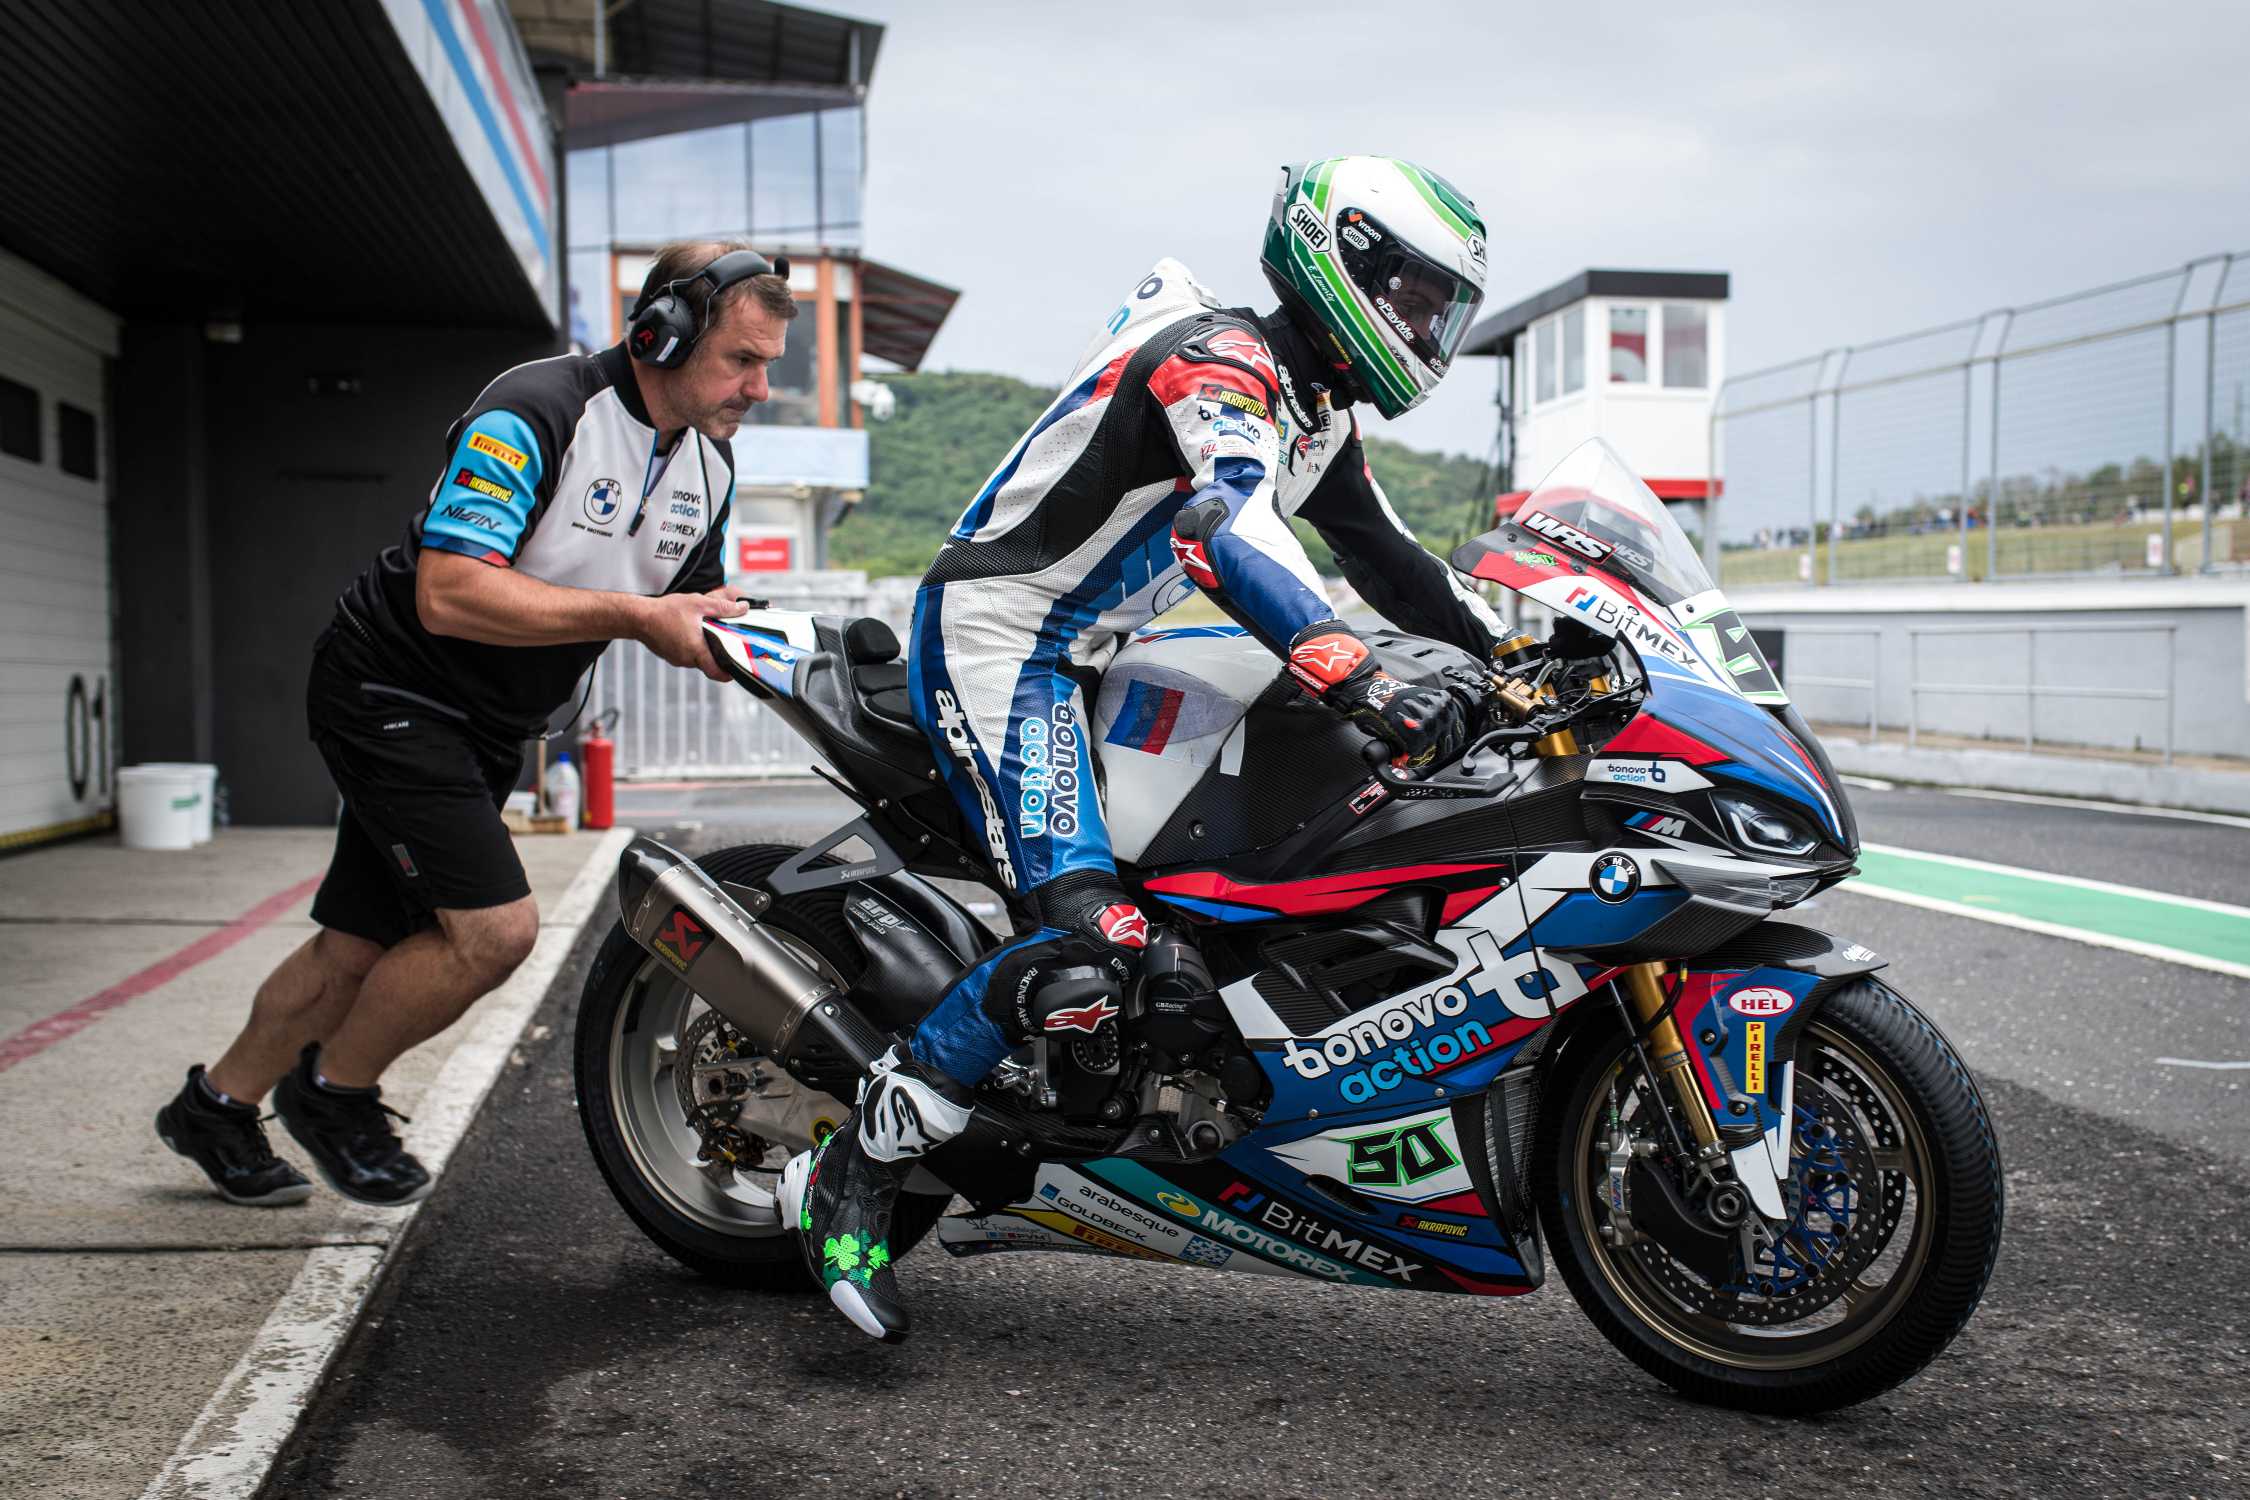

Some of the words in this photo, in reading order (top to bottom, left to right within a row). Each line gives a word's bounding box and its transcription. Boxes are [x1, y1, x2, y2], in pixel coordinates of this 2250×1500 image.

[1291, 208, 1328, 249] SHOEI
[1345, 228, 1366, 247] SHOEI
[1375, 297, 1415, 342] ePayMe
[1277, 364, 1313, 428] alpinestars
[656, 539, 685, 556] MGM
[1525, 511, 1613, 558] WRS
[1594, 600, 1698, 670] BitMEX
[66, 674, 107, 802] 01
[1051, 701, 1080, 838] bonovo
[1608, 764, 1647, 774] bonovo
[936, 690, 1017, 890] alpinestars
[1020, 717, 1049, 839] action
[1612, 773, 1646, 782] action
[1016, 966, 1040, 1004] RACING
[1741, 999, 1784, 1010] HEL
[1281, 983, 1469, 1081] bonovo
[1338, 1019, 1493, 1106] action
[1749, 1023, 1761, 1091] PIRELLI
[1347, 1115, 1462, 1187] 50
[1057, 1196, 1148, 1243] GOLDBECK
[1079, 1185, 1180, 1239] arabesque
[1259, 1201, 1425, 1283] BitMEX
[1201, 1210, 1357, 1284] MOTOREX
